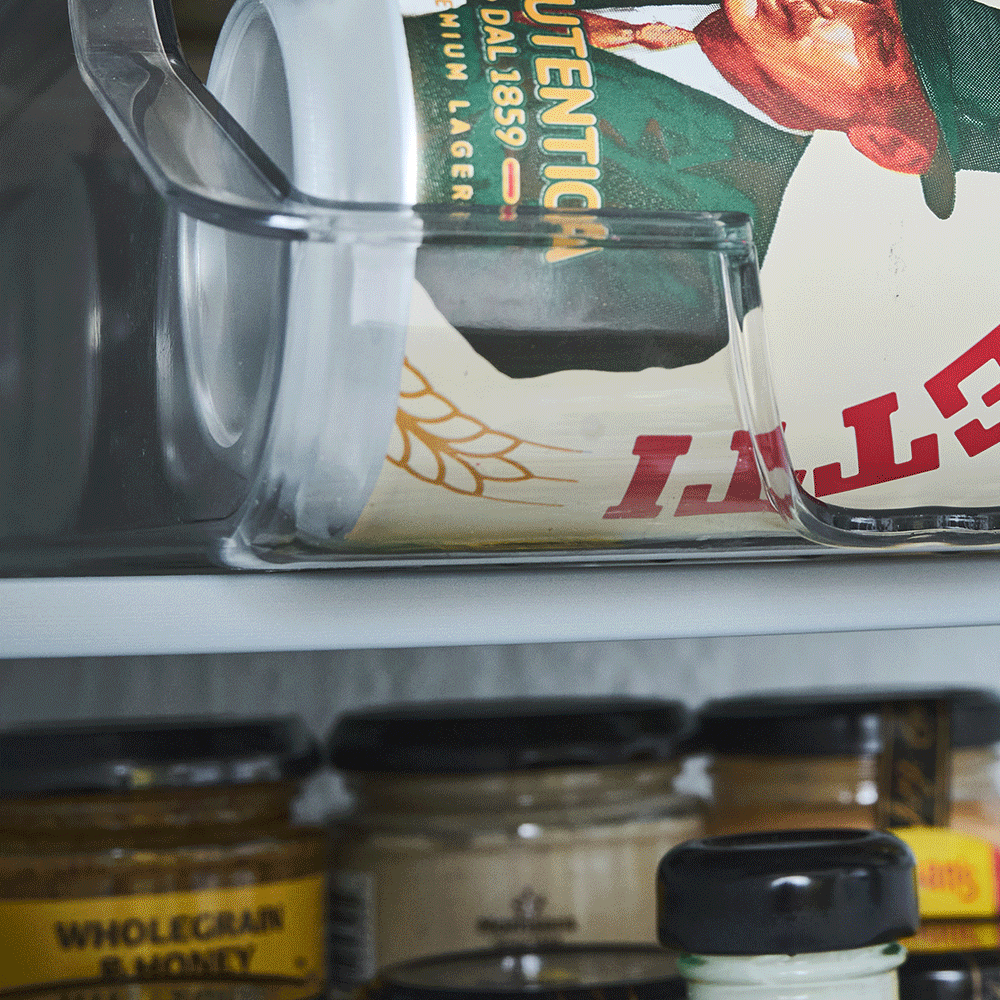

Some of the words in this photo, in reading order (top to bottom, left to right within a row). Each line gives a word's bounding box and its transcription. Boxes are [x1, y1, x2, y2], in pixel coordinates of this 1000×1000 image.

[479, 7, 518, 62] DAL
[489, 67, 528, 148] 1859
[448, 99, 475, 202] LAGER
[55, 905, 286, 949] WHOLEGRAIN
